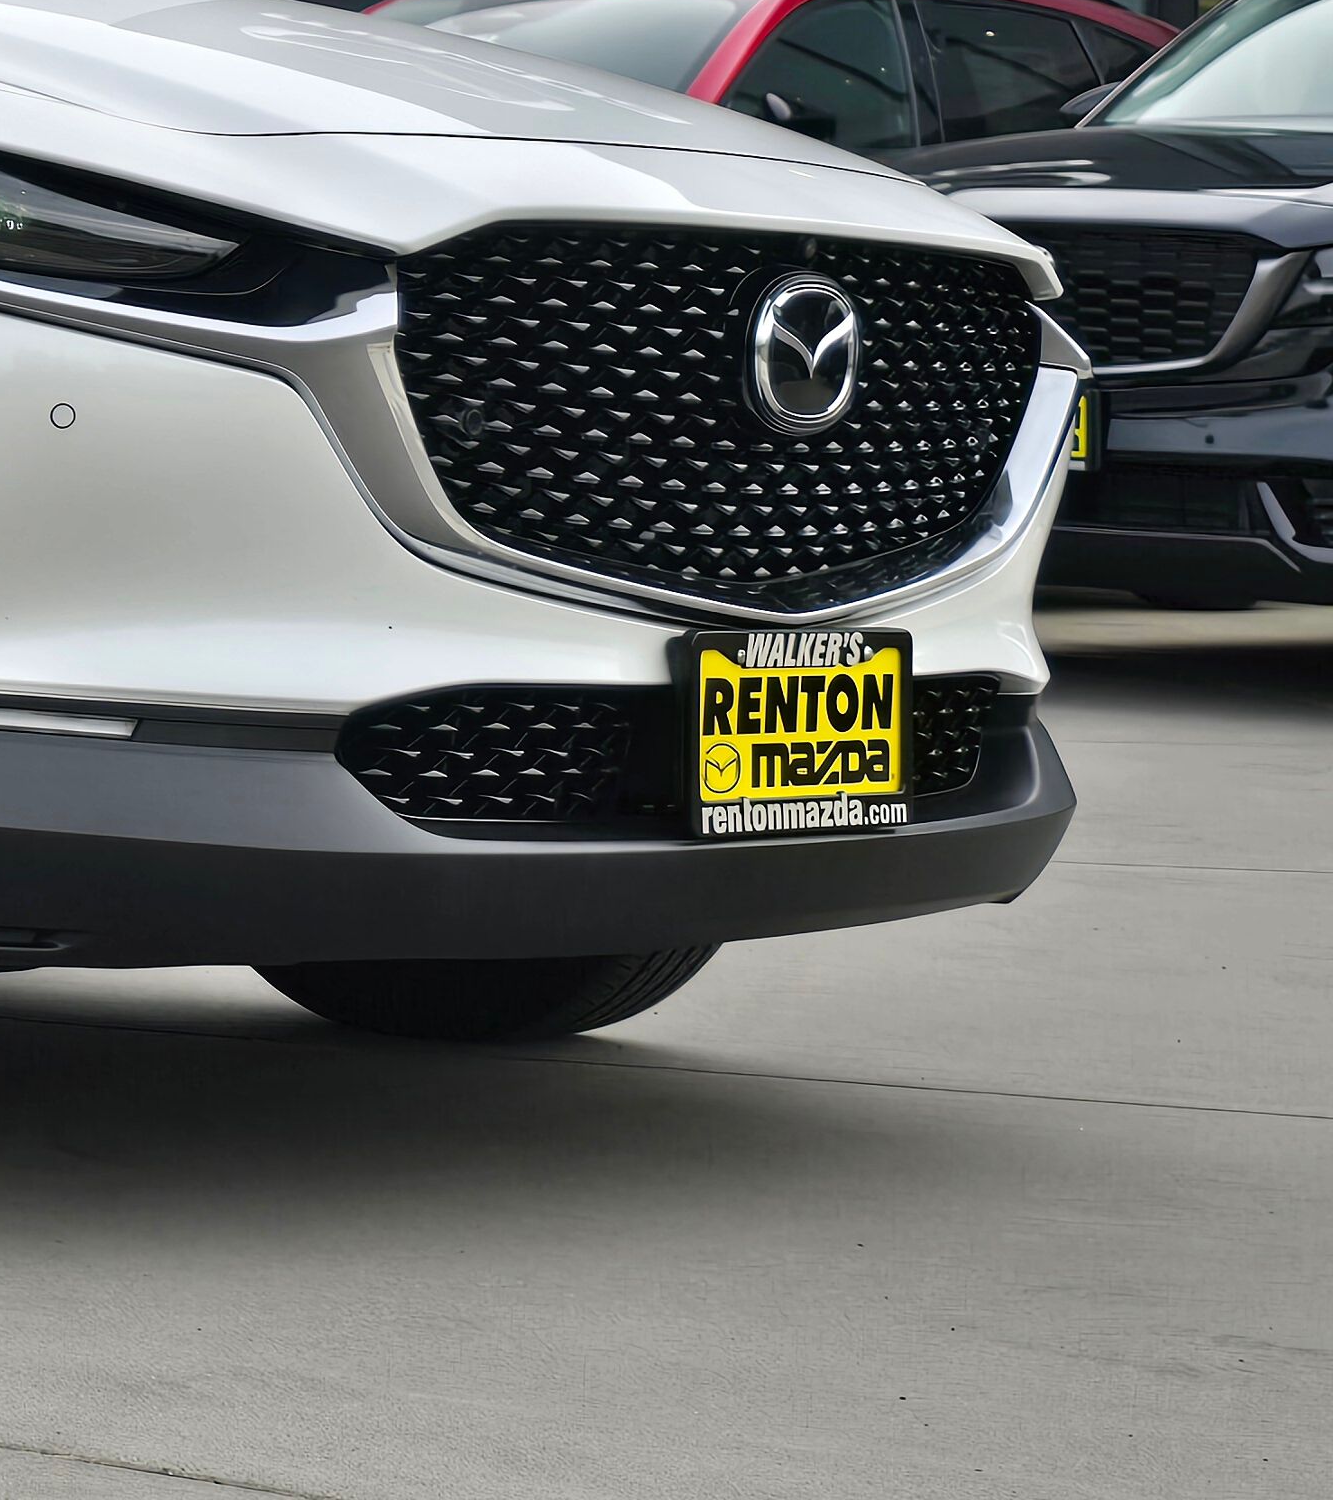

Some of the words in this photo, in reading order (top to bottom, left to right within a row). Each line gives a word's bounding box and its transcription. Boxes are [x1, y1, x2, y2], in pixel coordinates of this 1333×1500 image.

[745, 631, 864, 668] WALKER'S
[702, 673, 894, 736] RENTON
[701, 792, 908, 835] rentonmazda.com
